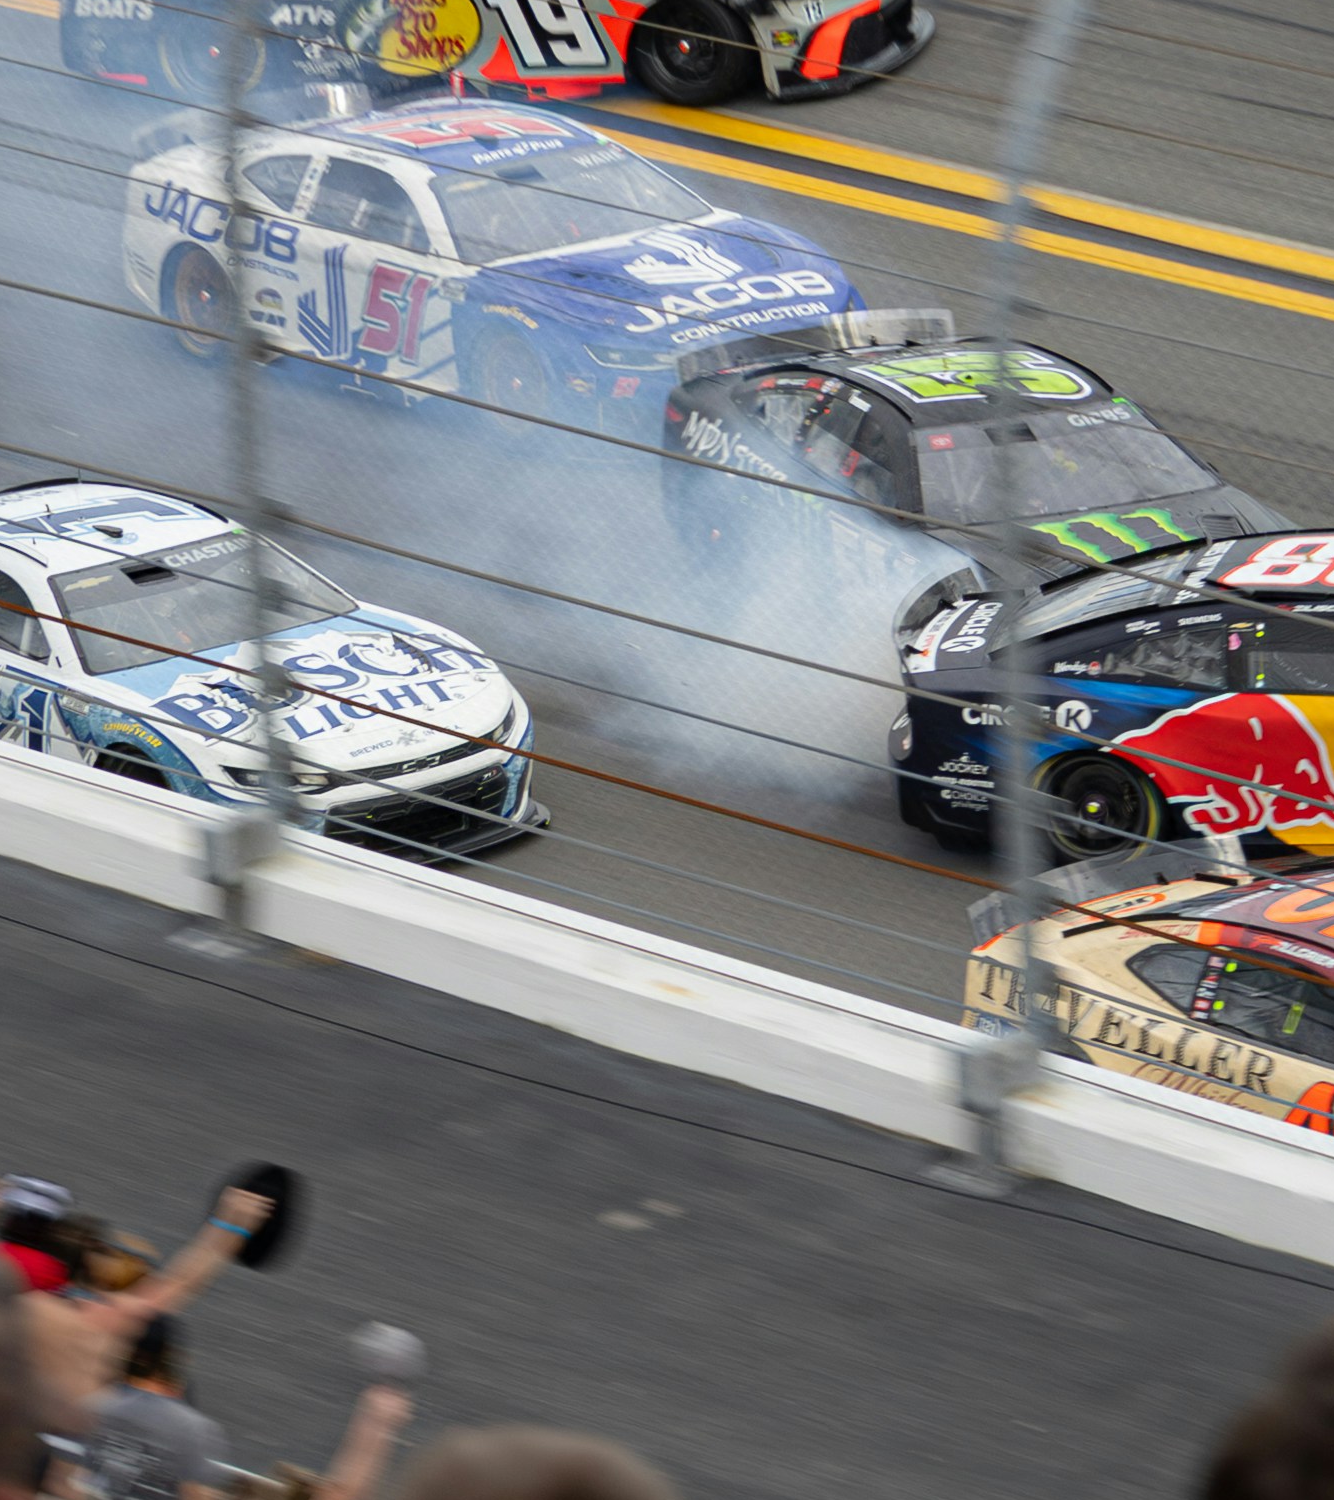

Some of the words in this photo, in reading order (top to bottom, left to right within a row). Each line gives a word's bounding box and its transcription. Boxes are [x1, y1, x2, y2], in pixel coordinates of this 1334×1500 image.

[270, 3, 338, 28] ATVs
[394, 8, 437, 35] Pro
[396, 30, 467, 66] Shops
[145, 180, 301, 264] JACOB
[357, 258, 439, 365] 51
[625, 269, 836, 334] JACOB
[670, 301, 830, 345] CONSTRUCTION
[1066, 406, 1132, 428] GIBBS
[957, 601, 1004, 638] CIRCLE
[21, 683, 56, 752] 1
[284, 677, 457, 741] LIGHT
[349, 739, 394, 759] BREWED
[938, 763, 990, 776] JOCKEY
